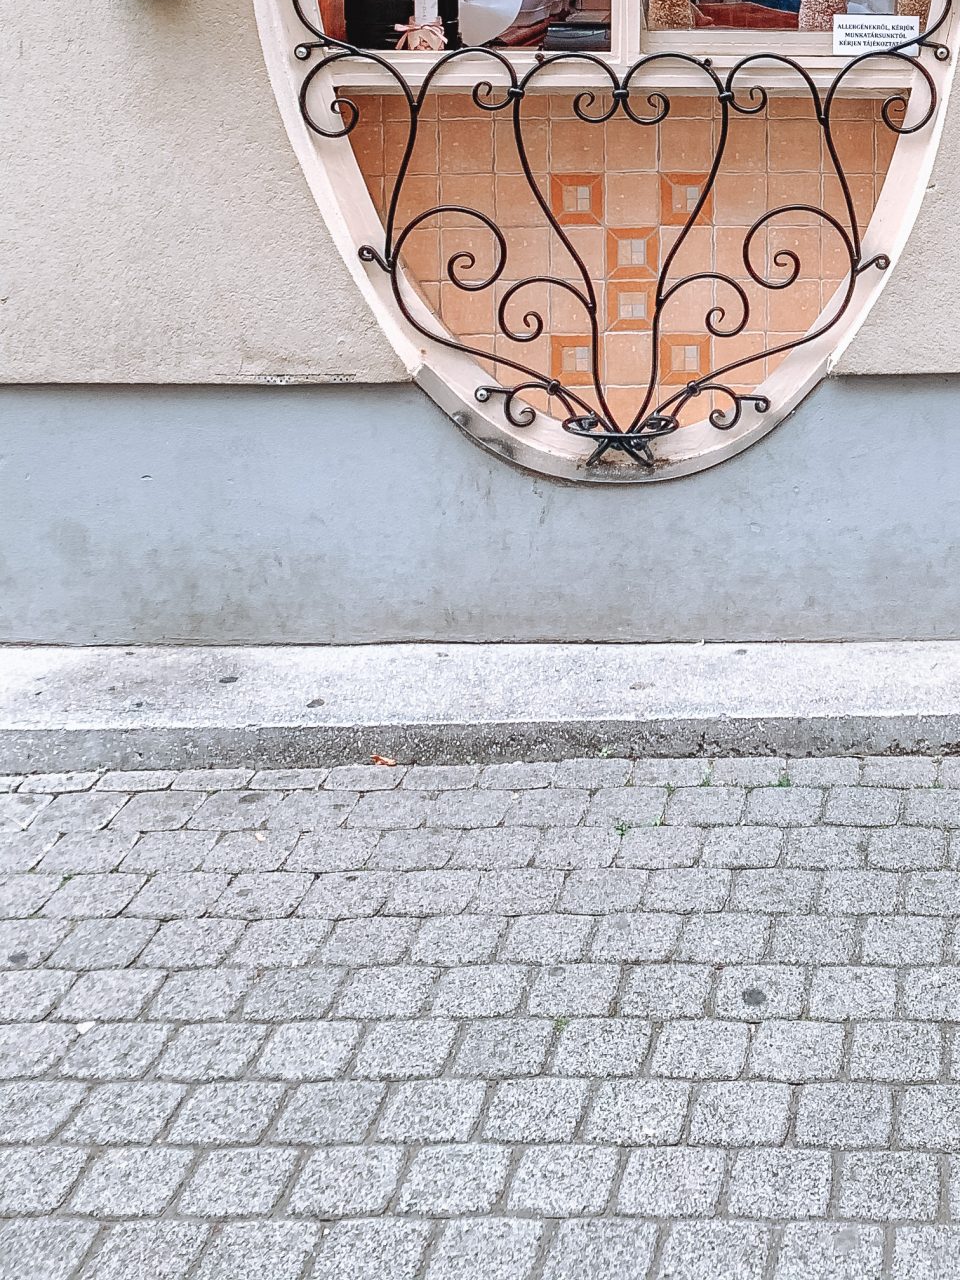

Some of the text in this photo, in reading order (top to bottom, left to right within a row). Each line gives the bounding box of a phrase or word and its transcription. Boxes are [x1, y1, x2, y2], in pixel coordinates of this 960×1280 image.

[891, 24, 915, 32] KÉRJÜK
[838, 39, 904, 48] KÉRJEN TÁJÉKOZTAT
